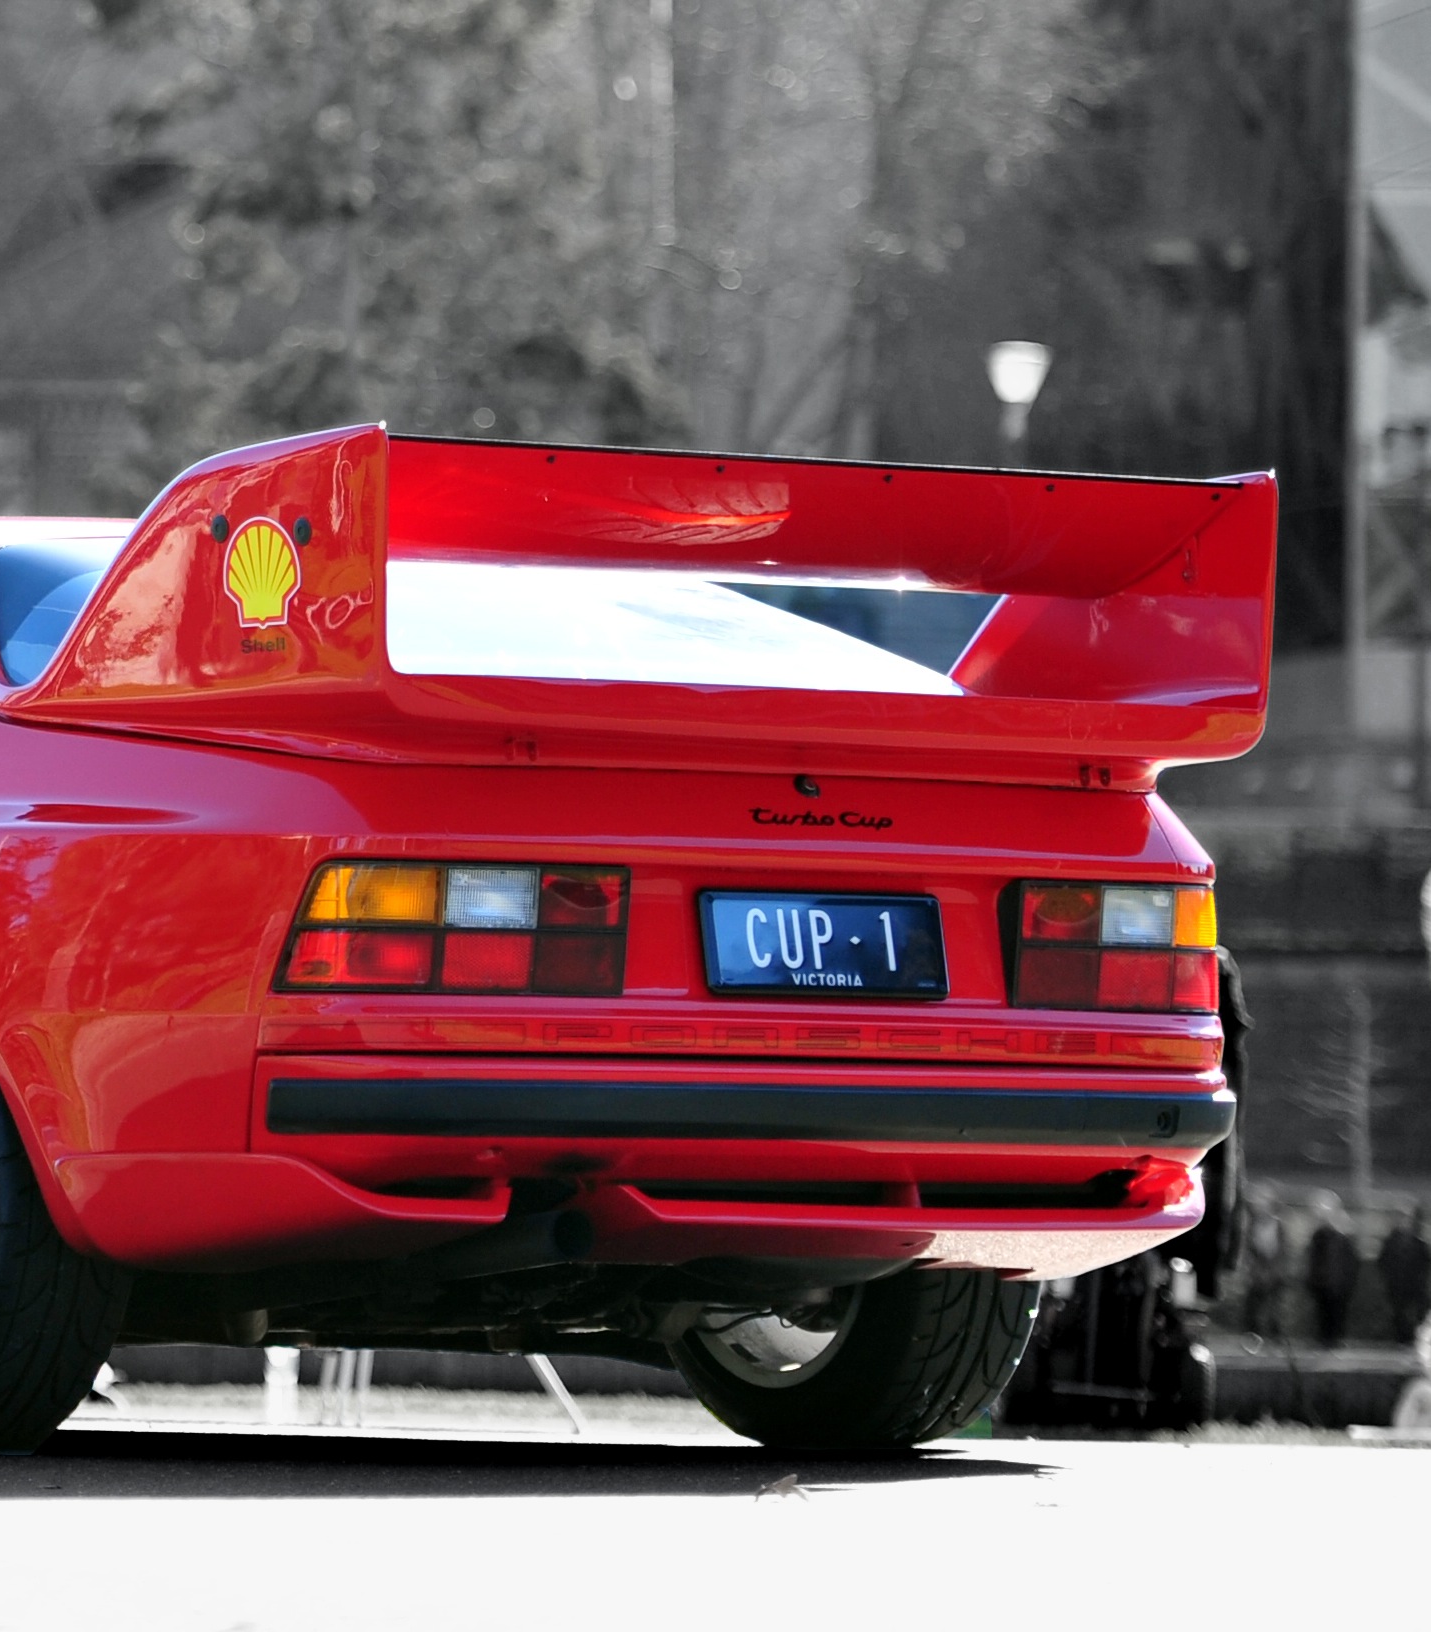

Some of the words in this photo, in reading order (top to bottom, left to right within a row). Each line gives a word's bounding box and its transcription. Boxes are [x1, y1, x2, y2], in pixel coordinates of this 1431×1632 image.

[241, 637, 286, 654] Shell
[839, 811, 893, 831] Cup
[746, 908, 833, 970] CUP
[879, 911, 897, 972] 1
[792, 973, 863, 987] VICTORIA
[542, 1023, 1097, 1054] PORSCHE
